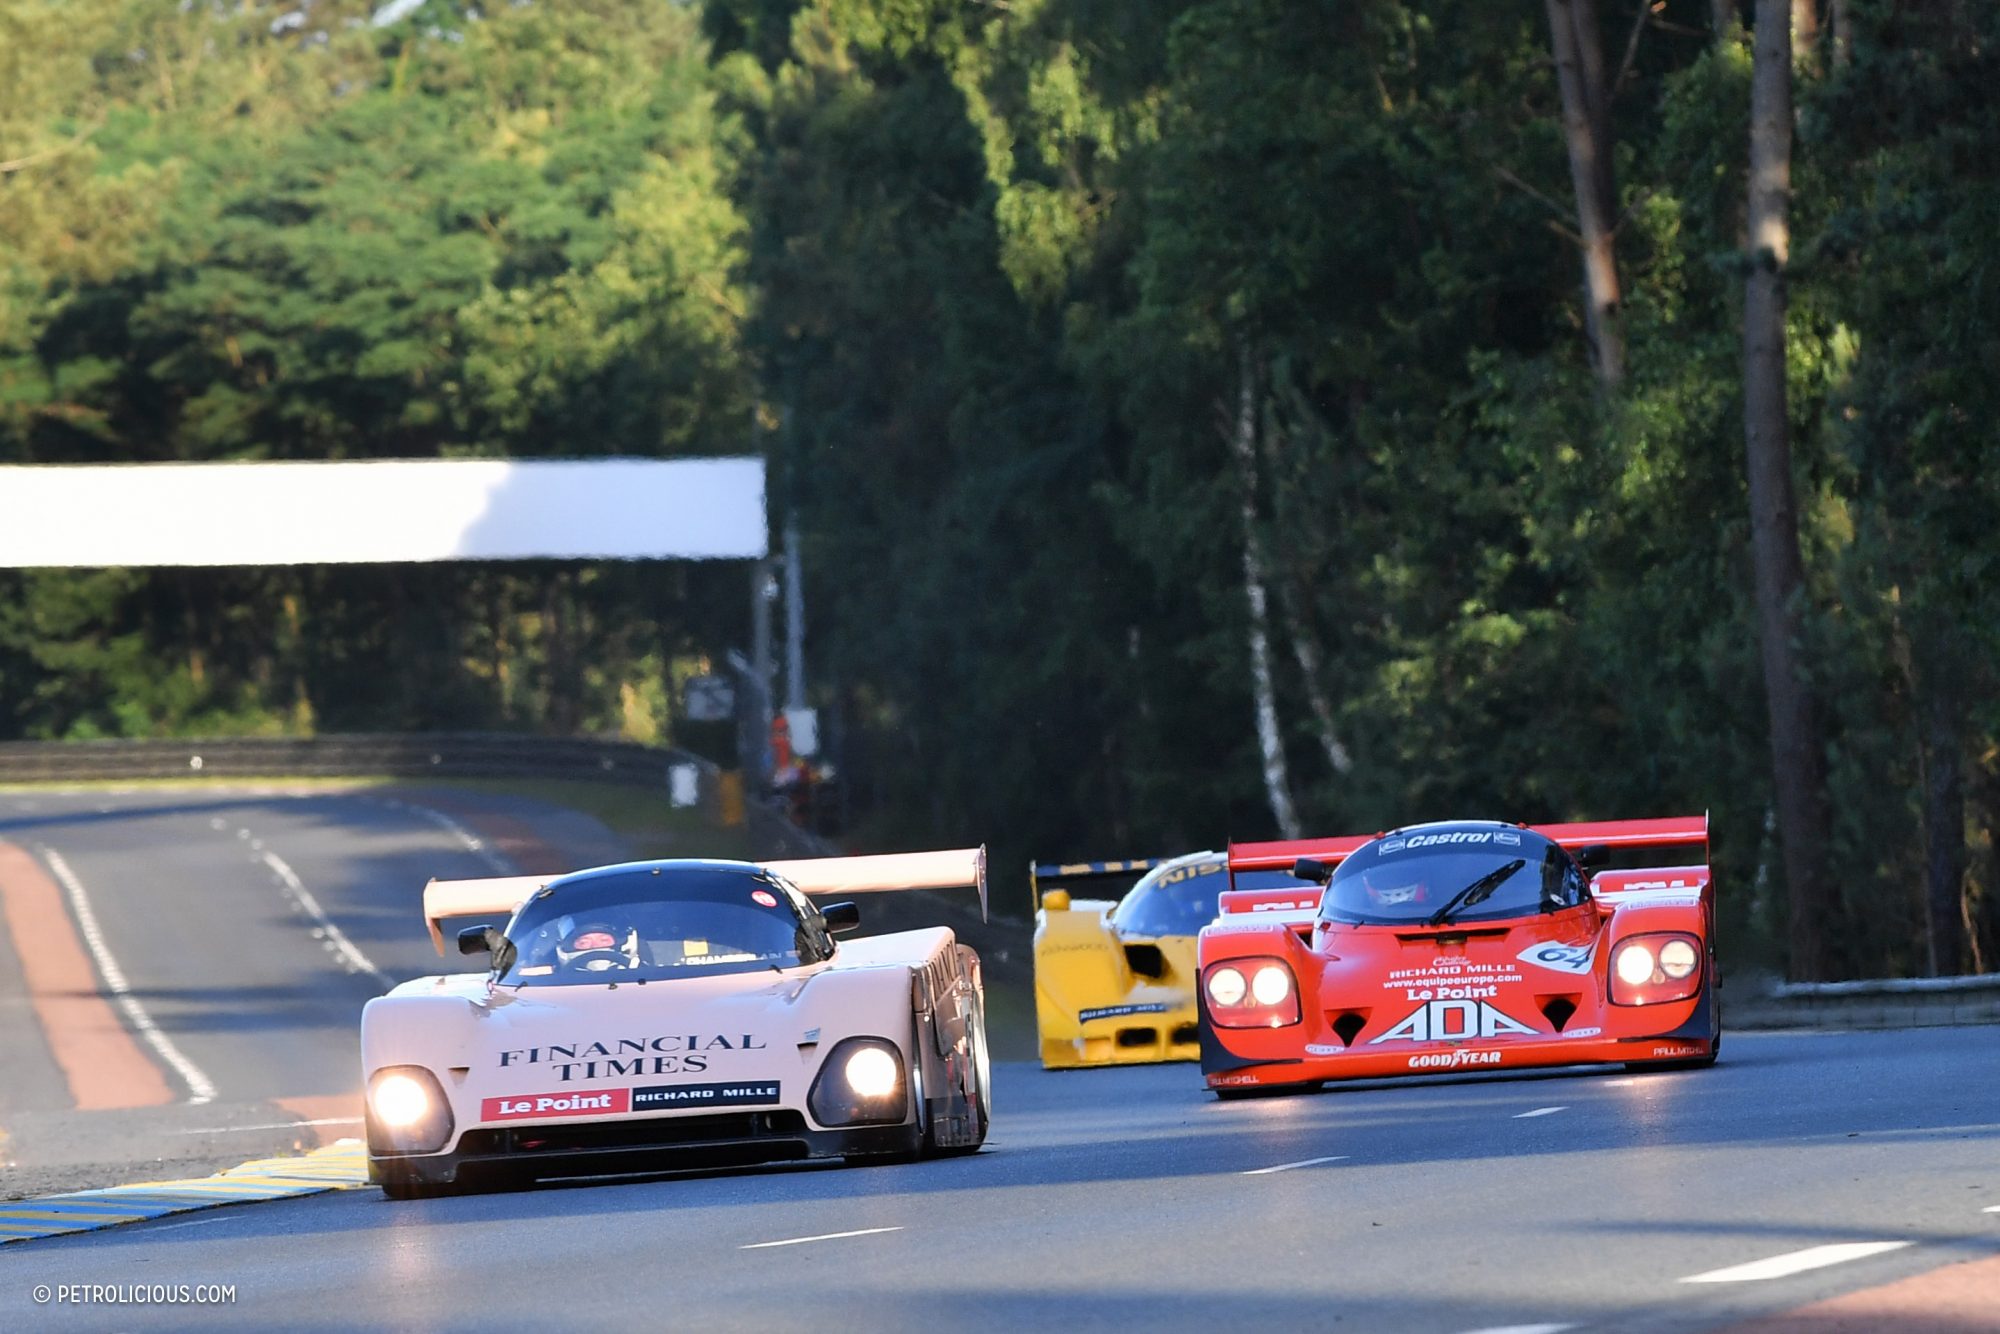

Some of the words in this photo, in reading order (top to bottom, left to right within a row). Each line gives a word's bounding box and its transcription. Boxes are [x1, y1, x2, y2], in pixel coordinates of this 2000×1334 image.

[1406, 831, 1493, 849] Castrol
[1537, 947, 1591, 969] 64
[1383, 973, 1522, 989] www.equipeeurope.com
[1389, 966, 1461, 979] RICHARD
[1466, 964, 1516, 974] MILLE
[1407, 988, 1433, 1001] Le
[1437, 985, 1498, 1000] Point
[1368, 999, 1543, 1046] ADA
[498, 1034, 768, 1068] FINANCIAL
[552, 1055, 709, 1082] TIMES
[498, 1100, 533, 1115] Le
[536, 1094, 612, 1112] Point
[635, 1090, 714, 1103] RICHARD
[723, 1087, 777, 1098] MILLE
